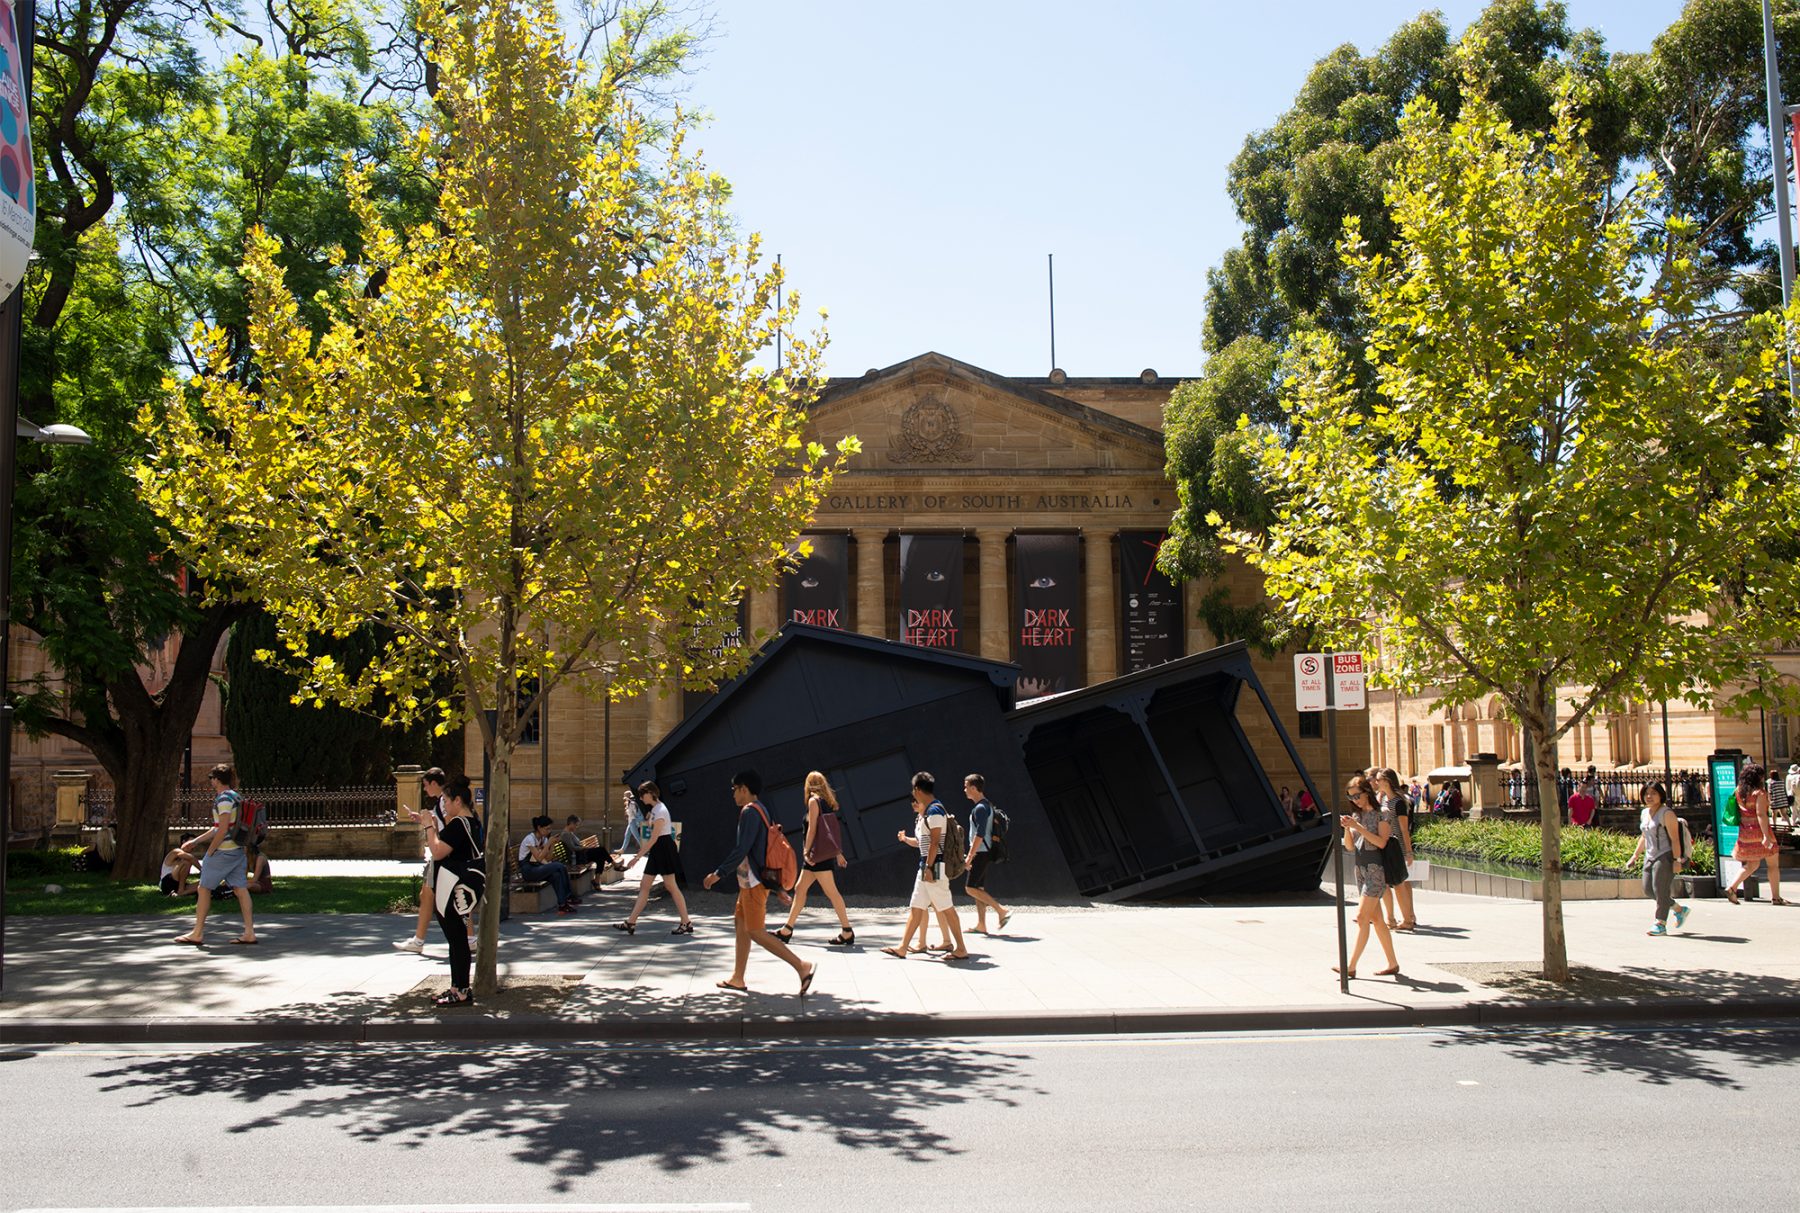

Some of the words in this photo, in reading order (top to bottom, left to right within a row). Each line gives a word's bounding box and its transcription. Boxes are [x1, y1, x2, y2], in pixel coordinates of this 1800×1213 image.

[830, 495, 908, 509] GALLERY
[924, 495, 946, 509] OF
[962, 495, 1020, 509] SOUTH
[1036, 495, 1133, 509] AUSTRALIA
[793, 608, 839, 627] DARK
[908, 608, 953, 627] DARK
[1024, 608, 1070, 627] DARK
[905, 627, 959, 647] HEART
[1021, 627, 1075, 647] HEART
[1336, 664, 1360, 672] ZONE
[1338, 655, 1357, 663] BUS
